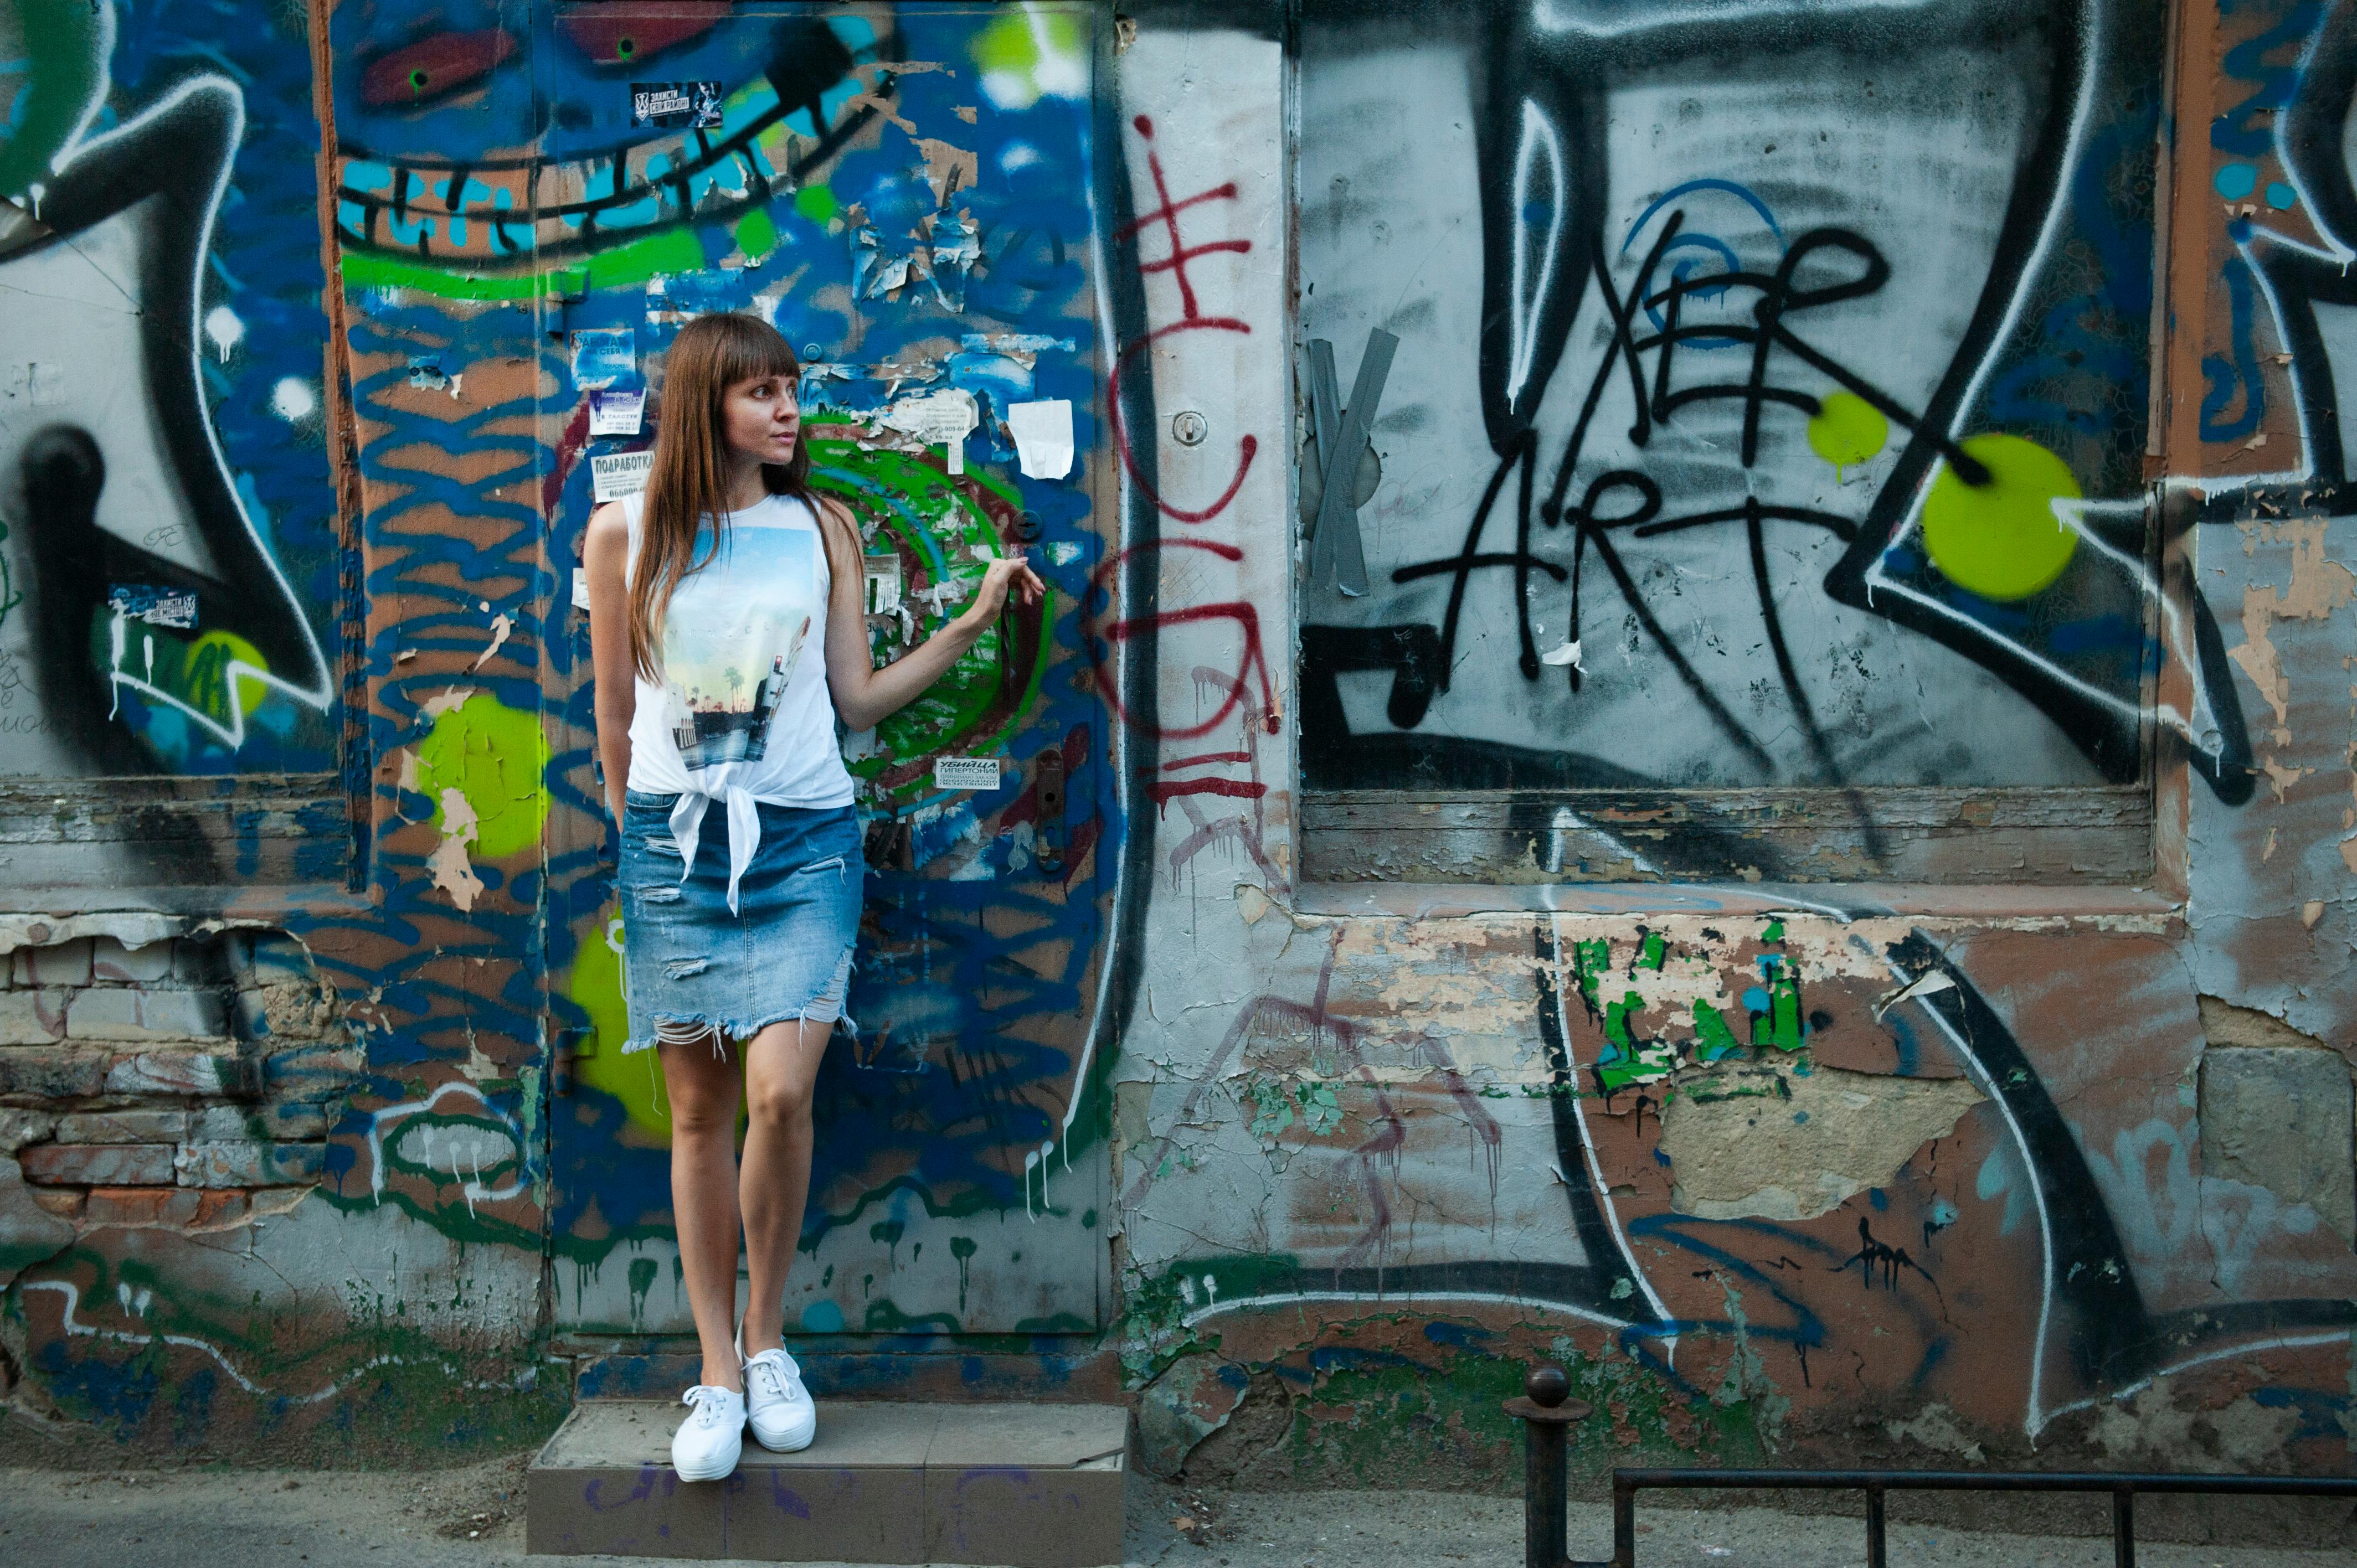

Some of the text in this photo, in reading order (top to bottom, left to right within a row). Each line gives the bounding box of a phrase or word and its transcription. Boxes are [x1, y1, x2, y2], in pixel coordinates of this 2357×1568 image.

[650, 90, 678, 102] ЗАХИСТИ
[651, 102, 665, 113] СВІЙ
[595, 455, 653, 474] ПОДРАБОТКА
[940, 760, 997, 768] УБИЙЦА
